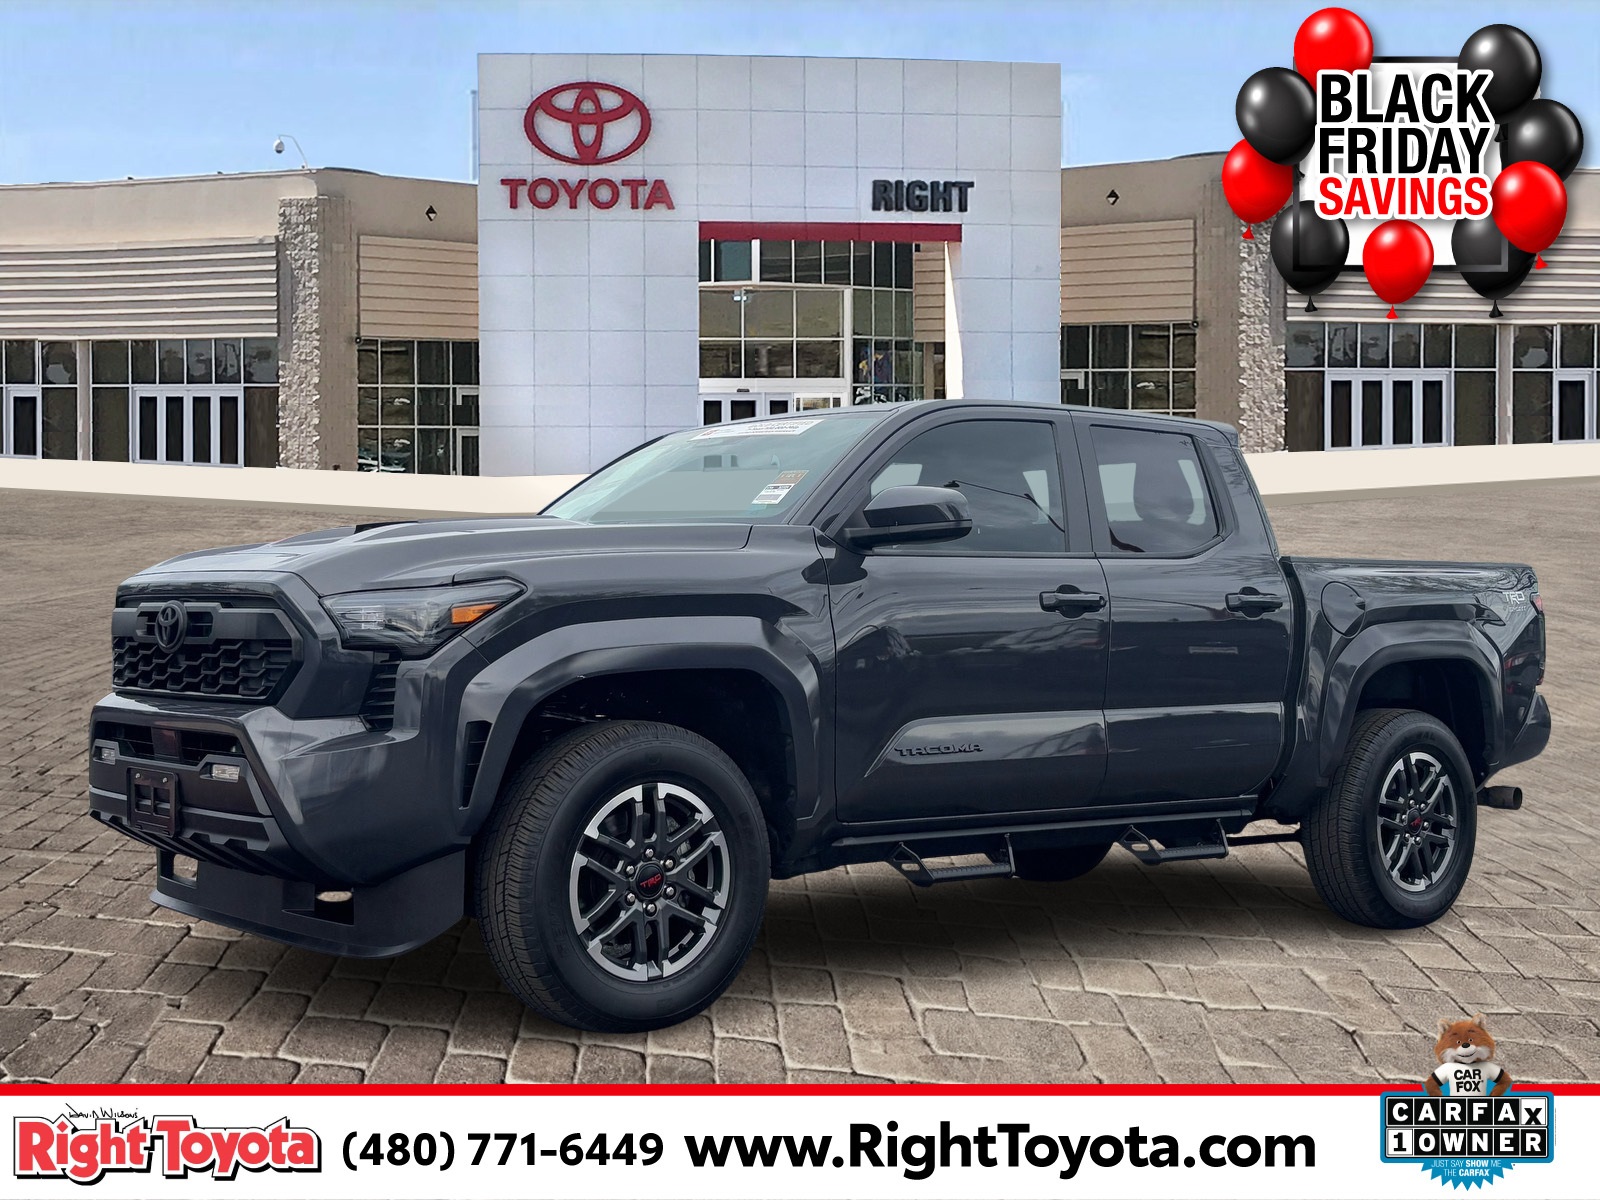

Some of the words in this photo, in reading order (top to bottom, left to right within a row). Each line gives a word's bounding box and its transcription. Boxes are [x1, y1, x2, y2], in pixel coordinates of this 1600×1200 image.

[502, 179, 672, 210] TOYOTA
[871, 180, 975, 213] RIGHT
[1502, 591, 1525, 604] TRD
[894, 743, 983, 757] TACOMA
[640, 873, 662, 888] TRD
